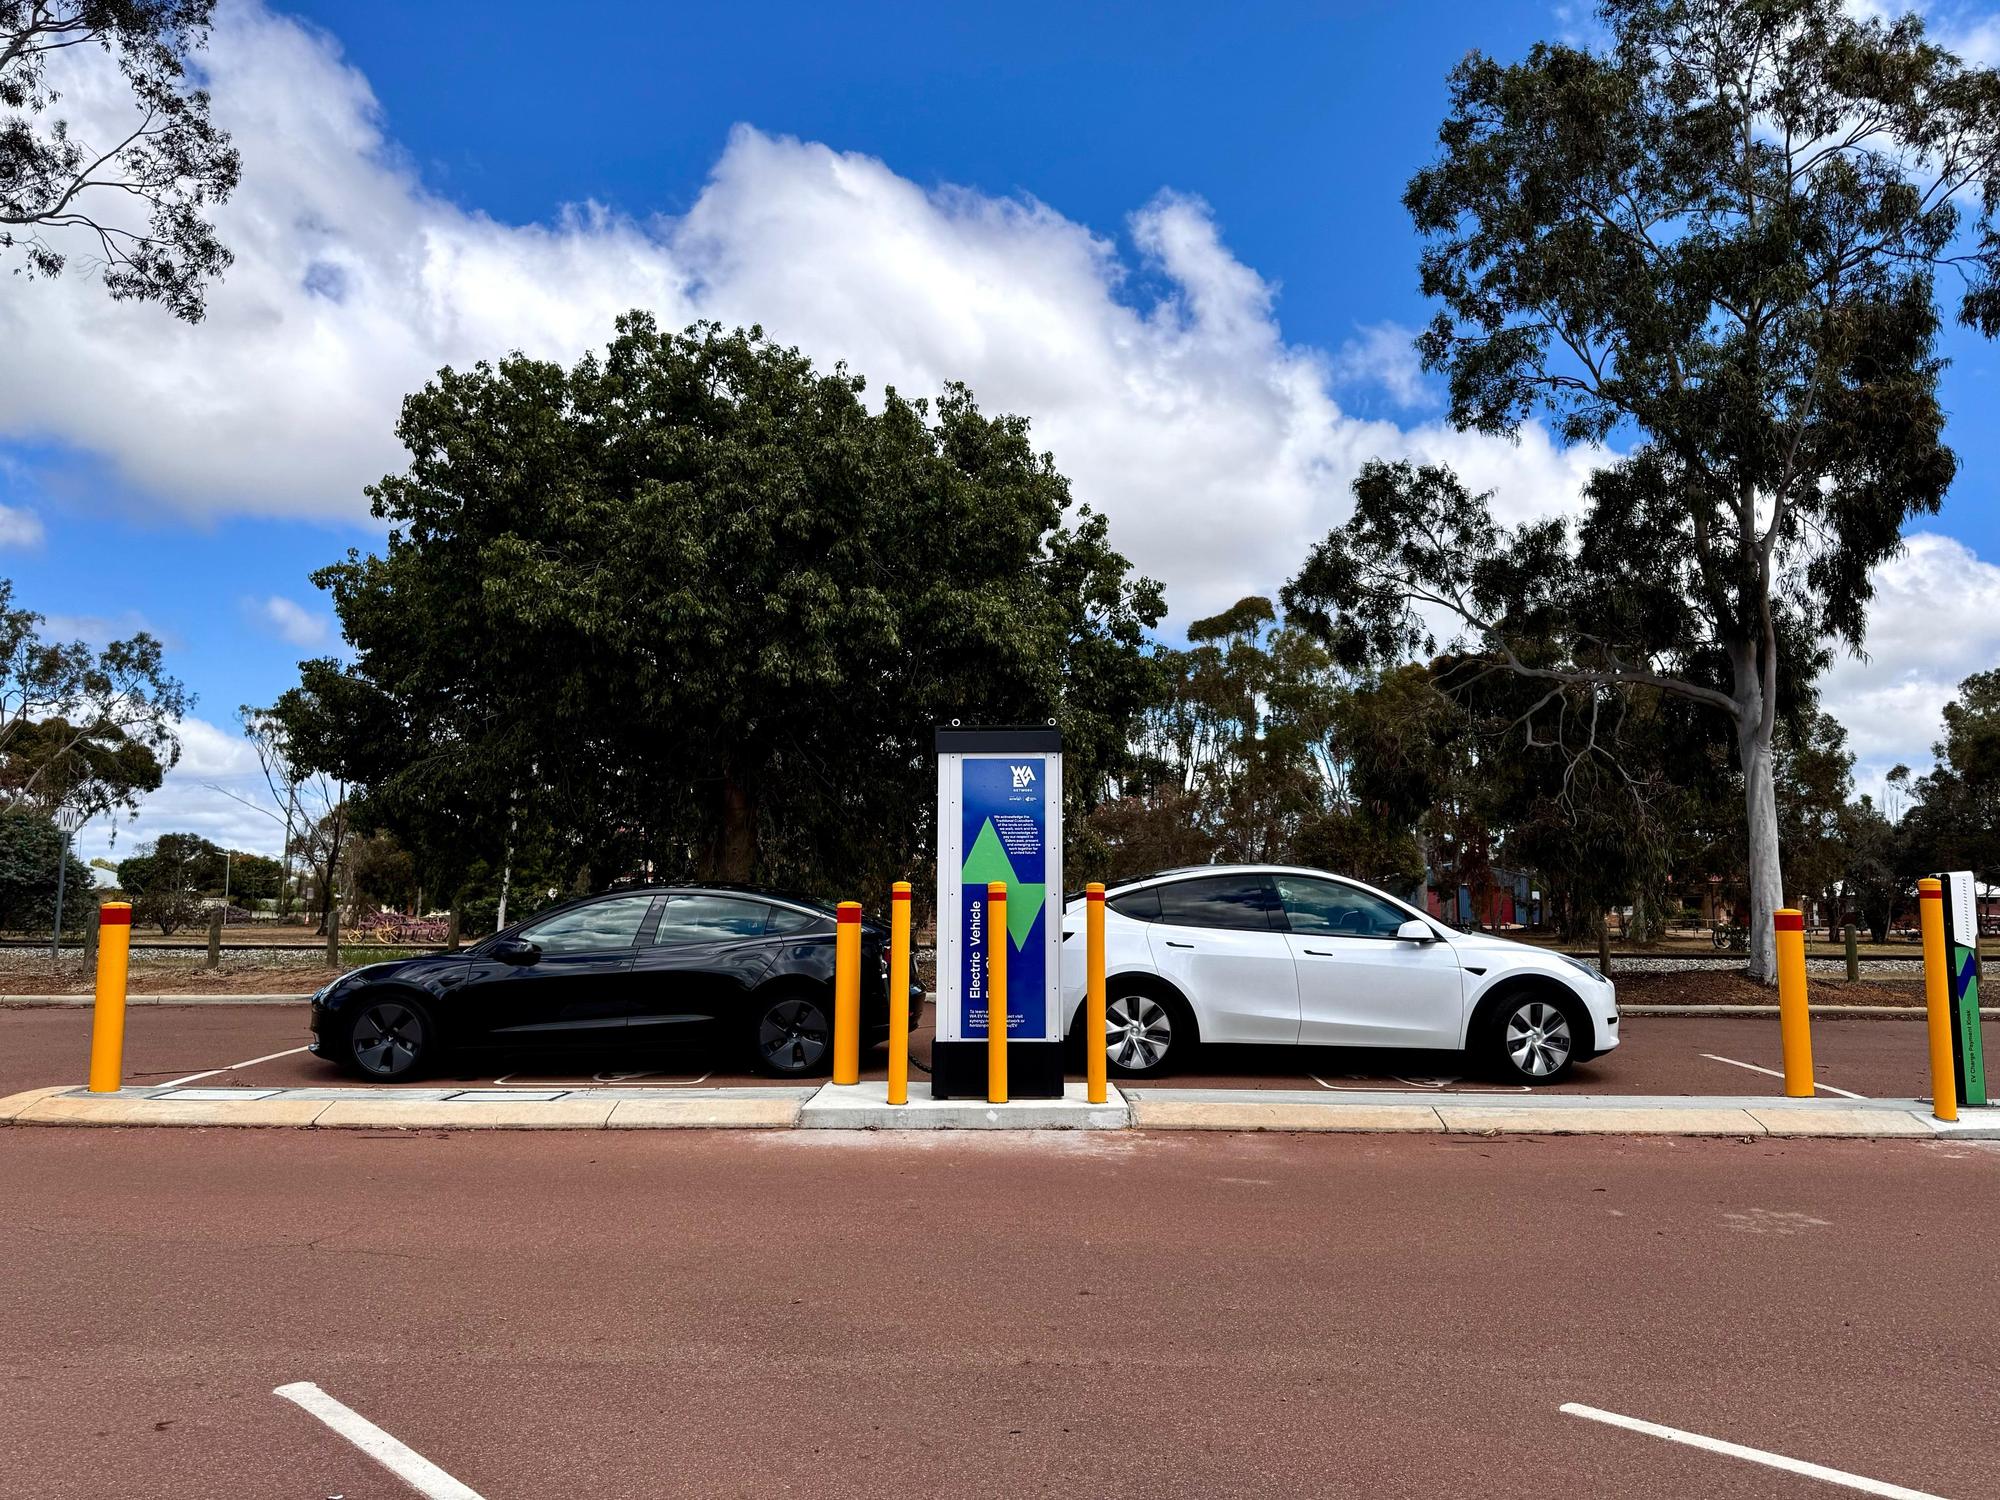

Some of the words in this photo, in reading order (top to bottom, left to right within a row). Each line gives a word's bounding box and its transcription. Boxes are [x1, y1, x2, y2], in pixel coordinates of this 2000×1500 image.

[64, 811, 74, 828] W
[970, 901, 980, 946] Vehicle
[970, 952, 980, 998] Electric
